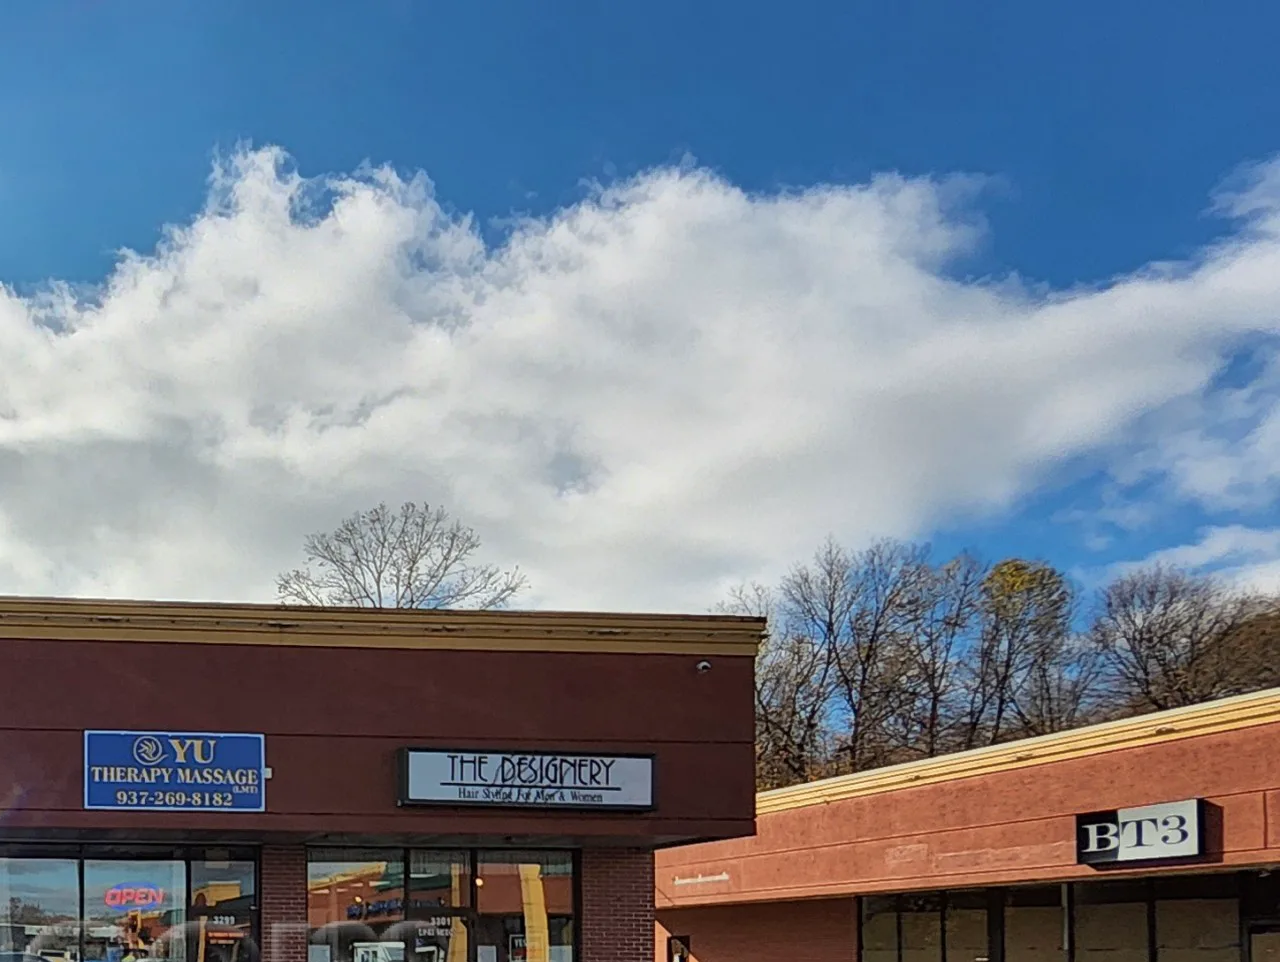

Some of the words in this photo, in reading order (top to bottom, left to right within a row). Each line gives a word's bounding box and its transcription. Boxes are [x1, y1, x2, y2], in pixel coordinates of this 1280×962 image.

[168, 738, 217, 765] YU
[90, 765, 173, 784] THERAPY
[177, 768, 259, 785] MASSAGE
[446, 754, 489, 783] THE
[500, 756, 616, 787] DESIGNERY
[116, 790, 233, 807] 937-269-8182
[458, 787, 479, 799] Hair
[570, 791, 604, 803] Women
[1081, 814, 1189, 853] BT3
[104, 888, 166, 906] OPEN
